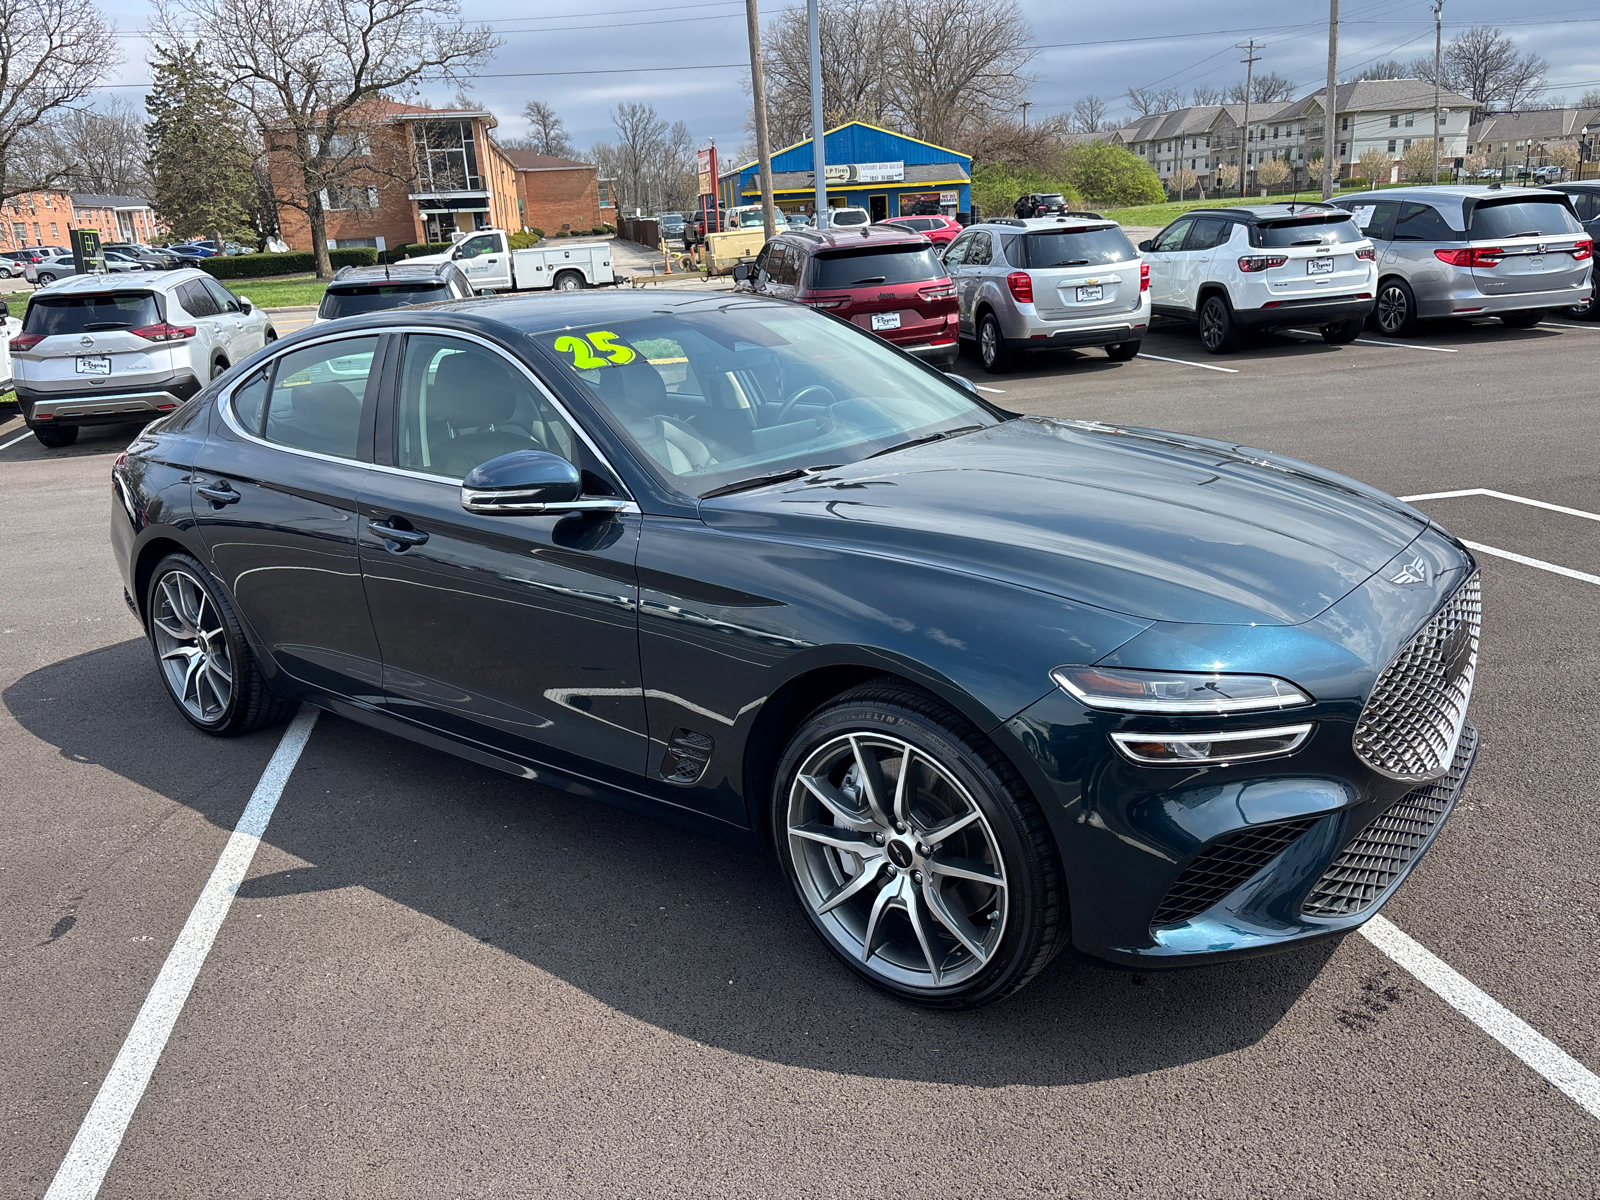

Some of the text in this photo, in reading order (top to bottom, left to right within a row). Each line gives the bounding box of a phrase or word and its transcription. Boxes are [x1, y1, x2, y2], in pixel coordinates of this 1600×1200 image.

[1310, 261, 1331, 270] Byers
[1080, 289, 1100, 297] Byers
[874, 316, 898, 325] Byers
[554, 330, 636, 369] 25
[80, 360, 107, 369] Byers
[836, 712, 896, 724] MICHELIN
[905, 720, 929, 738] PRIMACY
[930, 735, 947, 749] TOUR
